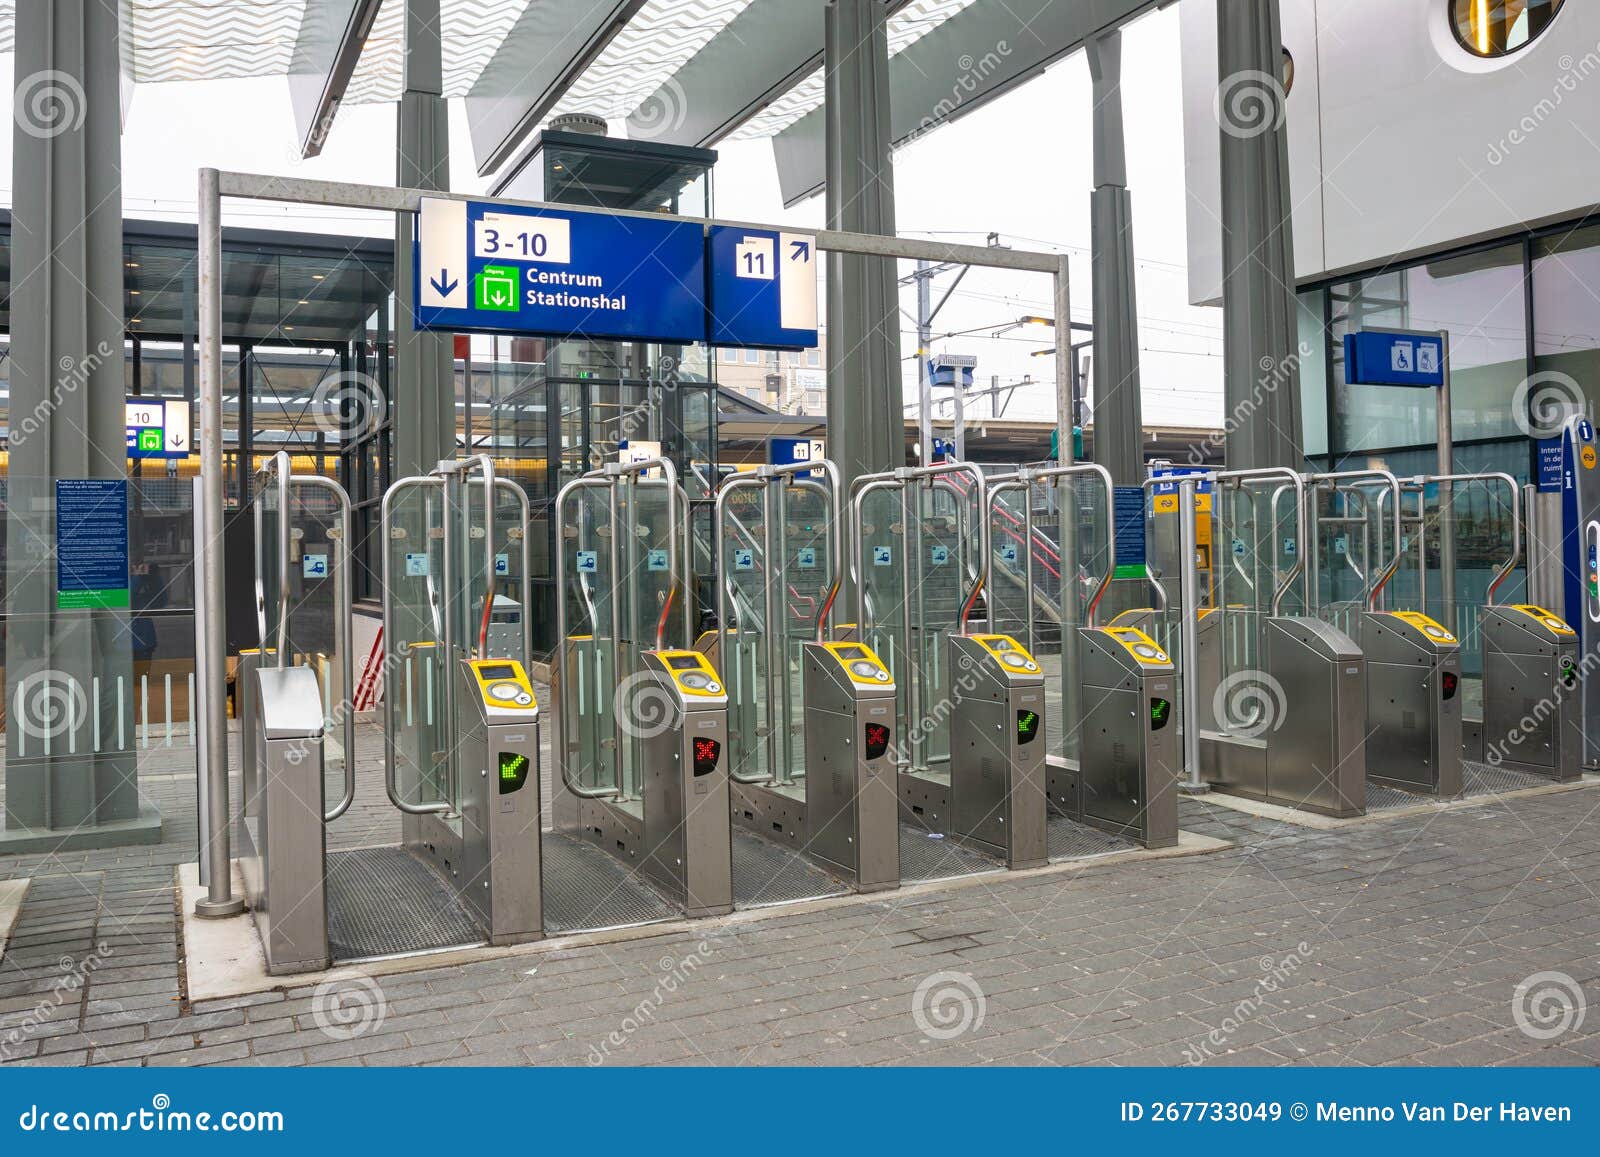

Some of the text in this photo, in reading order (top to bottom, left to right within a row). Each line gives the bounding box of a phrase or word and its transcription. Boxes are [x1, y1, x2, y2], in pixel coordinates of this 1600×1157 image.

[743, 252, 765, 275] 11
[526, 268, 603, 288] Centrum
[526, 290, 626, 311] Stationshal
[797, 448, 806, 458] 11
